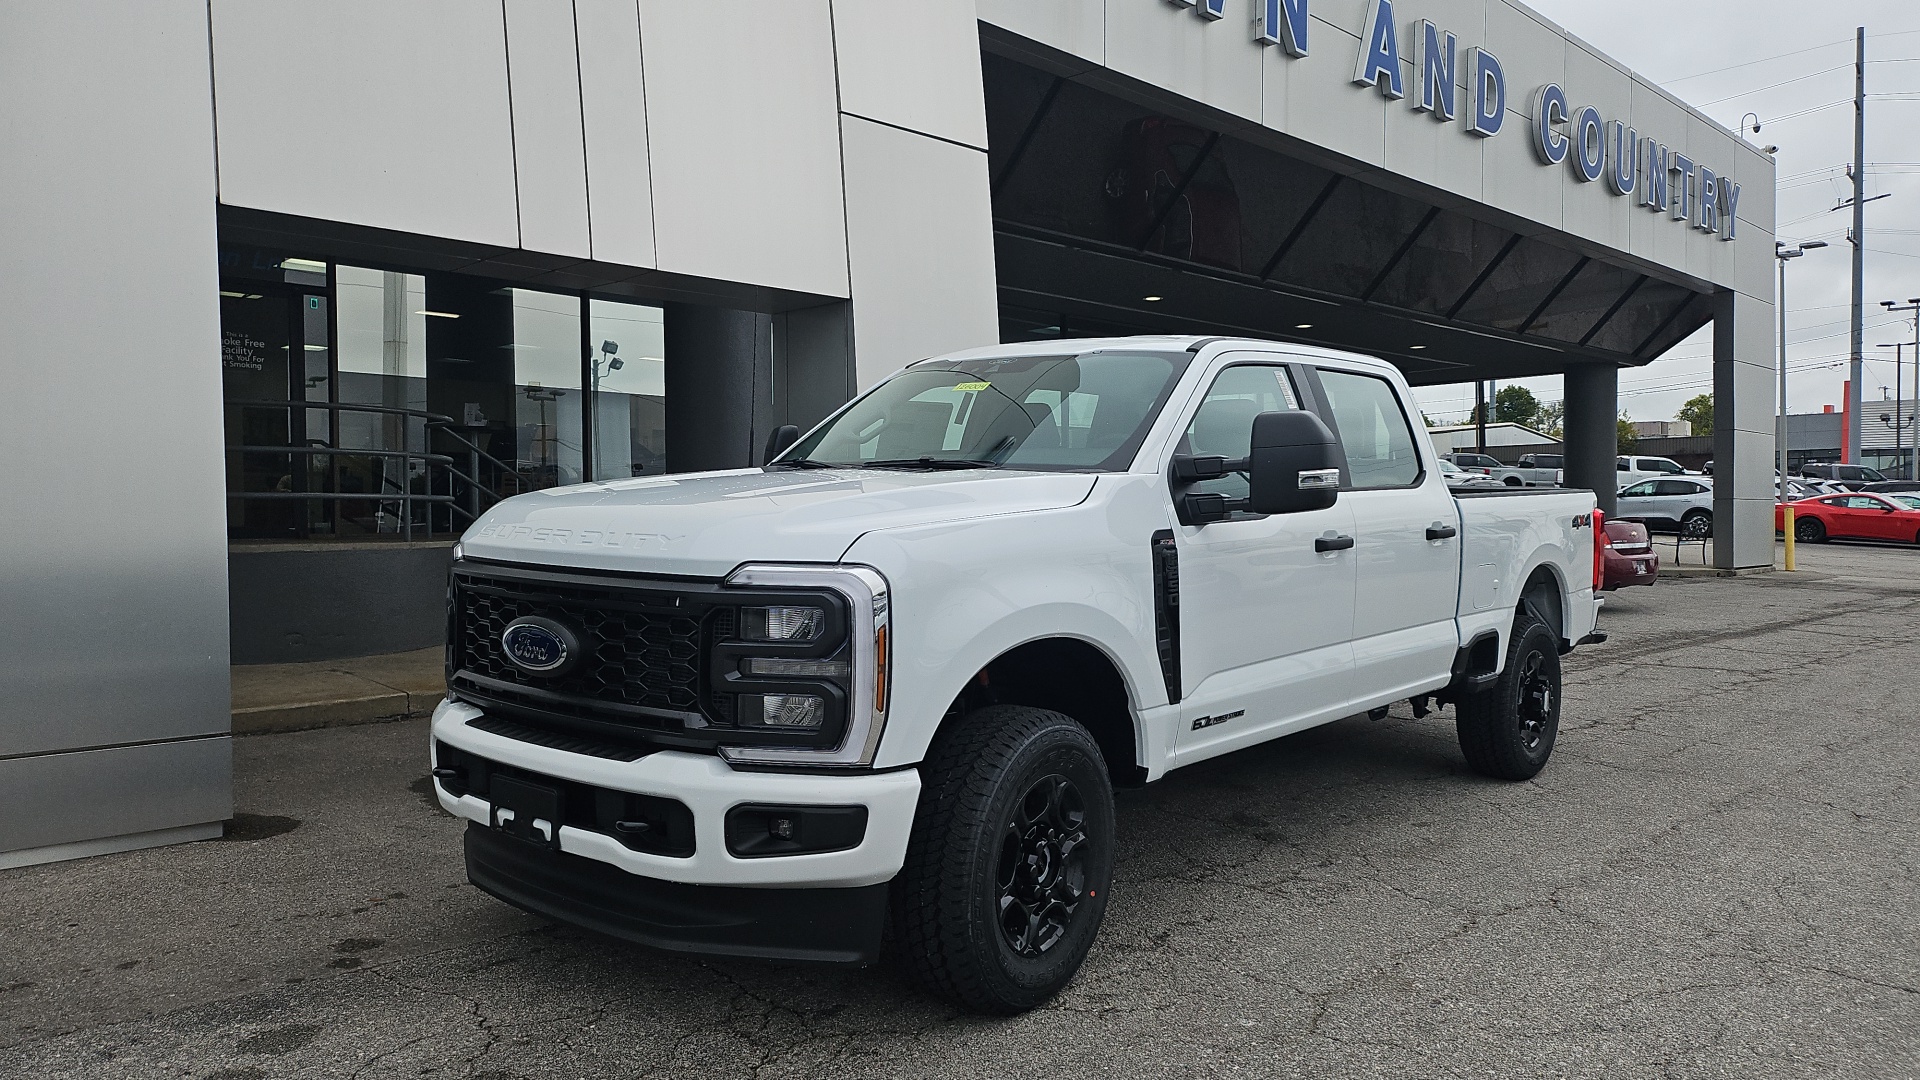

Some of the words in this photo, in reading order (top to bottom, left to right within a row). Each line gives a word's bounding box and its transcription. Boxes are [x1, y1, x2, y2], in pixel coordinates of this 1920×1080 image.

[1353, 0, 1506, 137] AND
[1532, 82, 1742, 242] COUNTRY
[221, 337, 241, 346] oke
[244, 338, 265, 348] Free
[229, 360, 262, 371] Smoking
[236, 354, 250, 362] You
[252, 355, 265, 363] For
[477, 523, 574, 545] SUPER
[576, 529, 686, 551] DUTY
[514, 630, 550, 662] Ford
